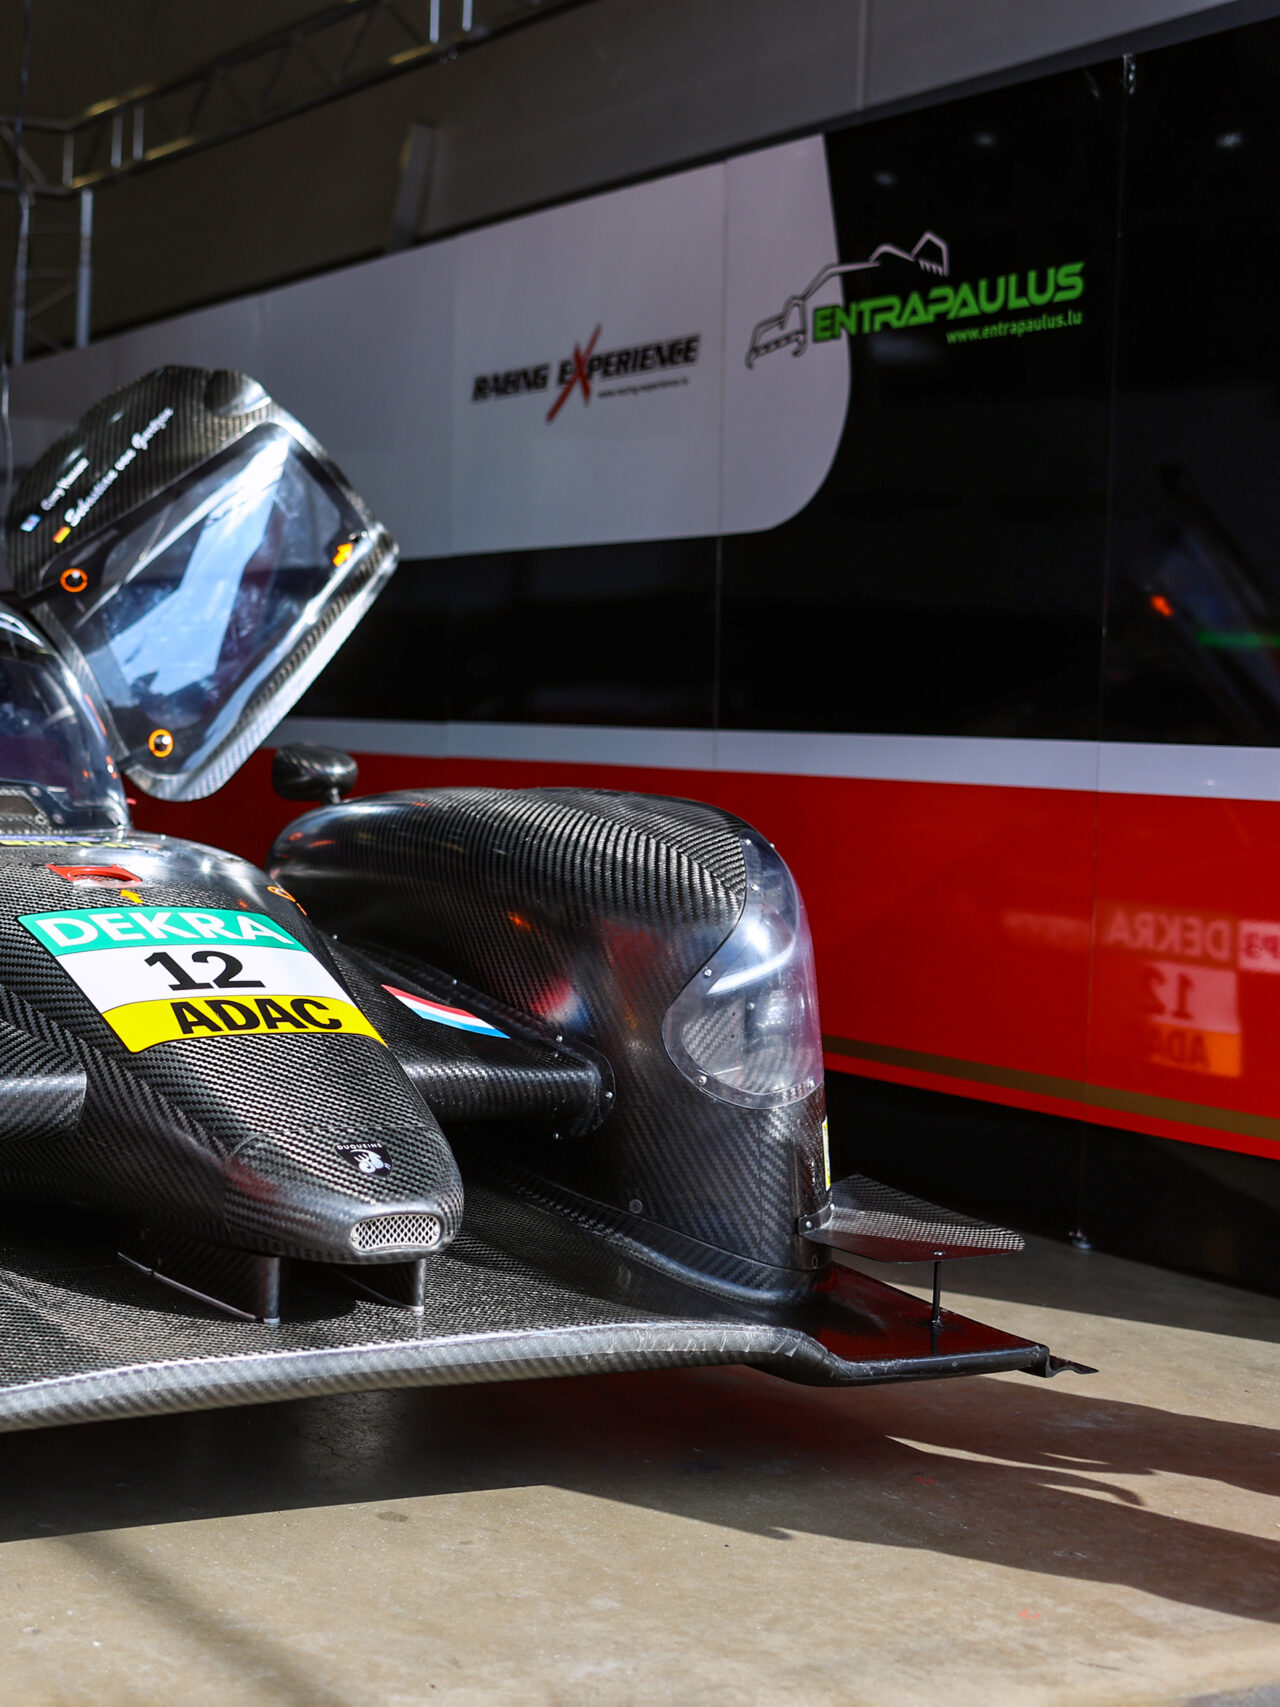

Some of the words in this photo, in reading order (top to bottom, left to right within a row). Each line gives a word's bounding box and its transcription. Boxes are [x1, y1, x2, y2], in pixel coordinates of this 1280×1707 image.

[812, 261, 1085, 343] ENTRAPAULUS
[946, 310, 1083, 345] www.entrapaulus.lu
[473, 363, 550, 403] RACING
[546, 325, 701, 421] EXPERIENCE
[35, 912, 295, 947] DEKRA
[144, 950, 266, 991] 12
[170, 998, 343, 1035] ADAC
